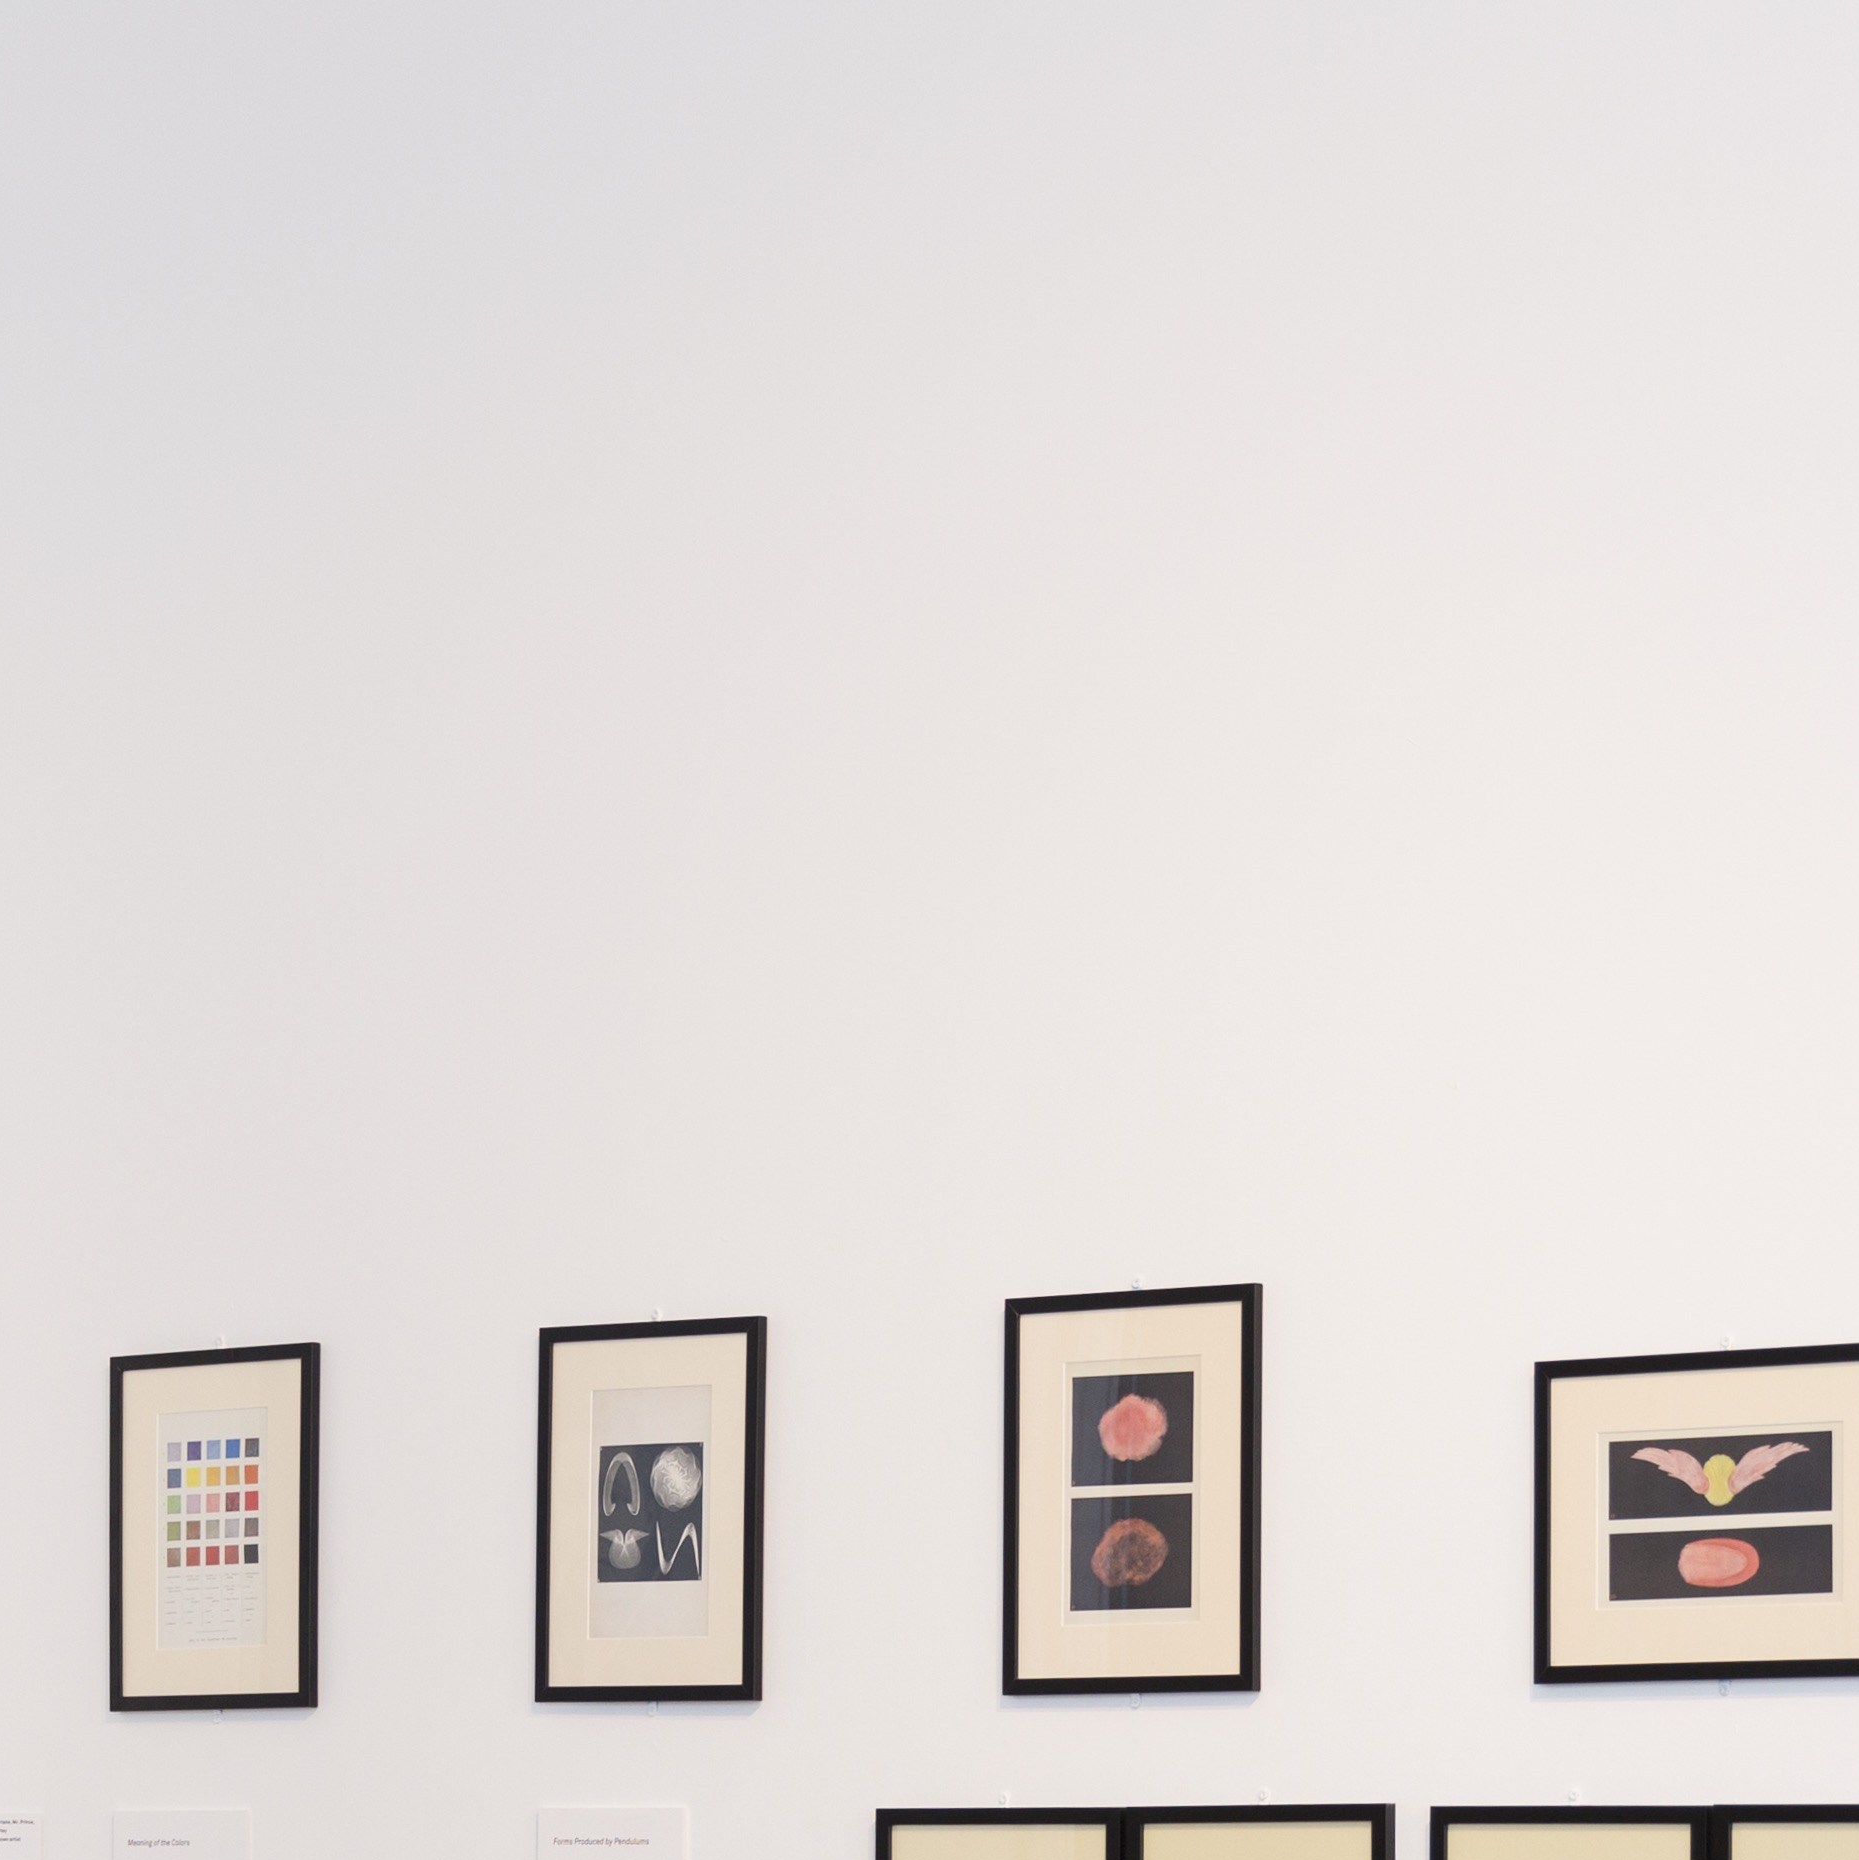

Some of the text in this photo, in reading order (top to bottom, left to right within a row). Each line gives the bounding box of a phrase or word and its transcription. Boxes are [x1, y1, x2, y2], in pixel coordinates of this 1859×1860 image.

[128, 1839, 152, 1848] Meaning
[553, 1837, 572, 1846] Forms
[605, 1838, 612, 1847] by
